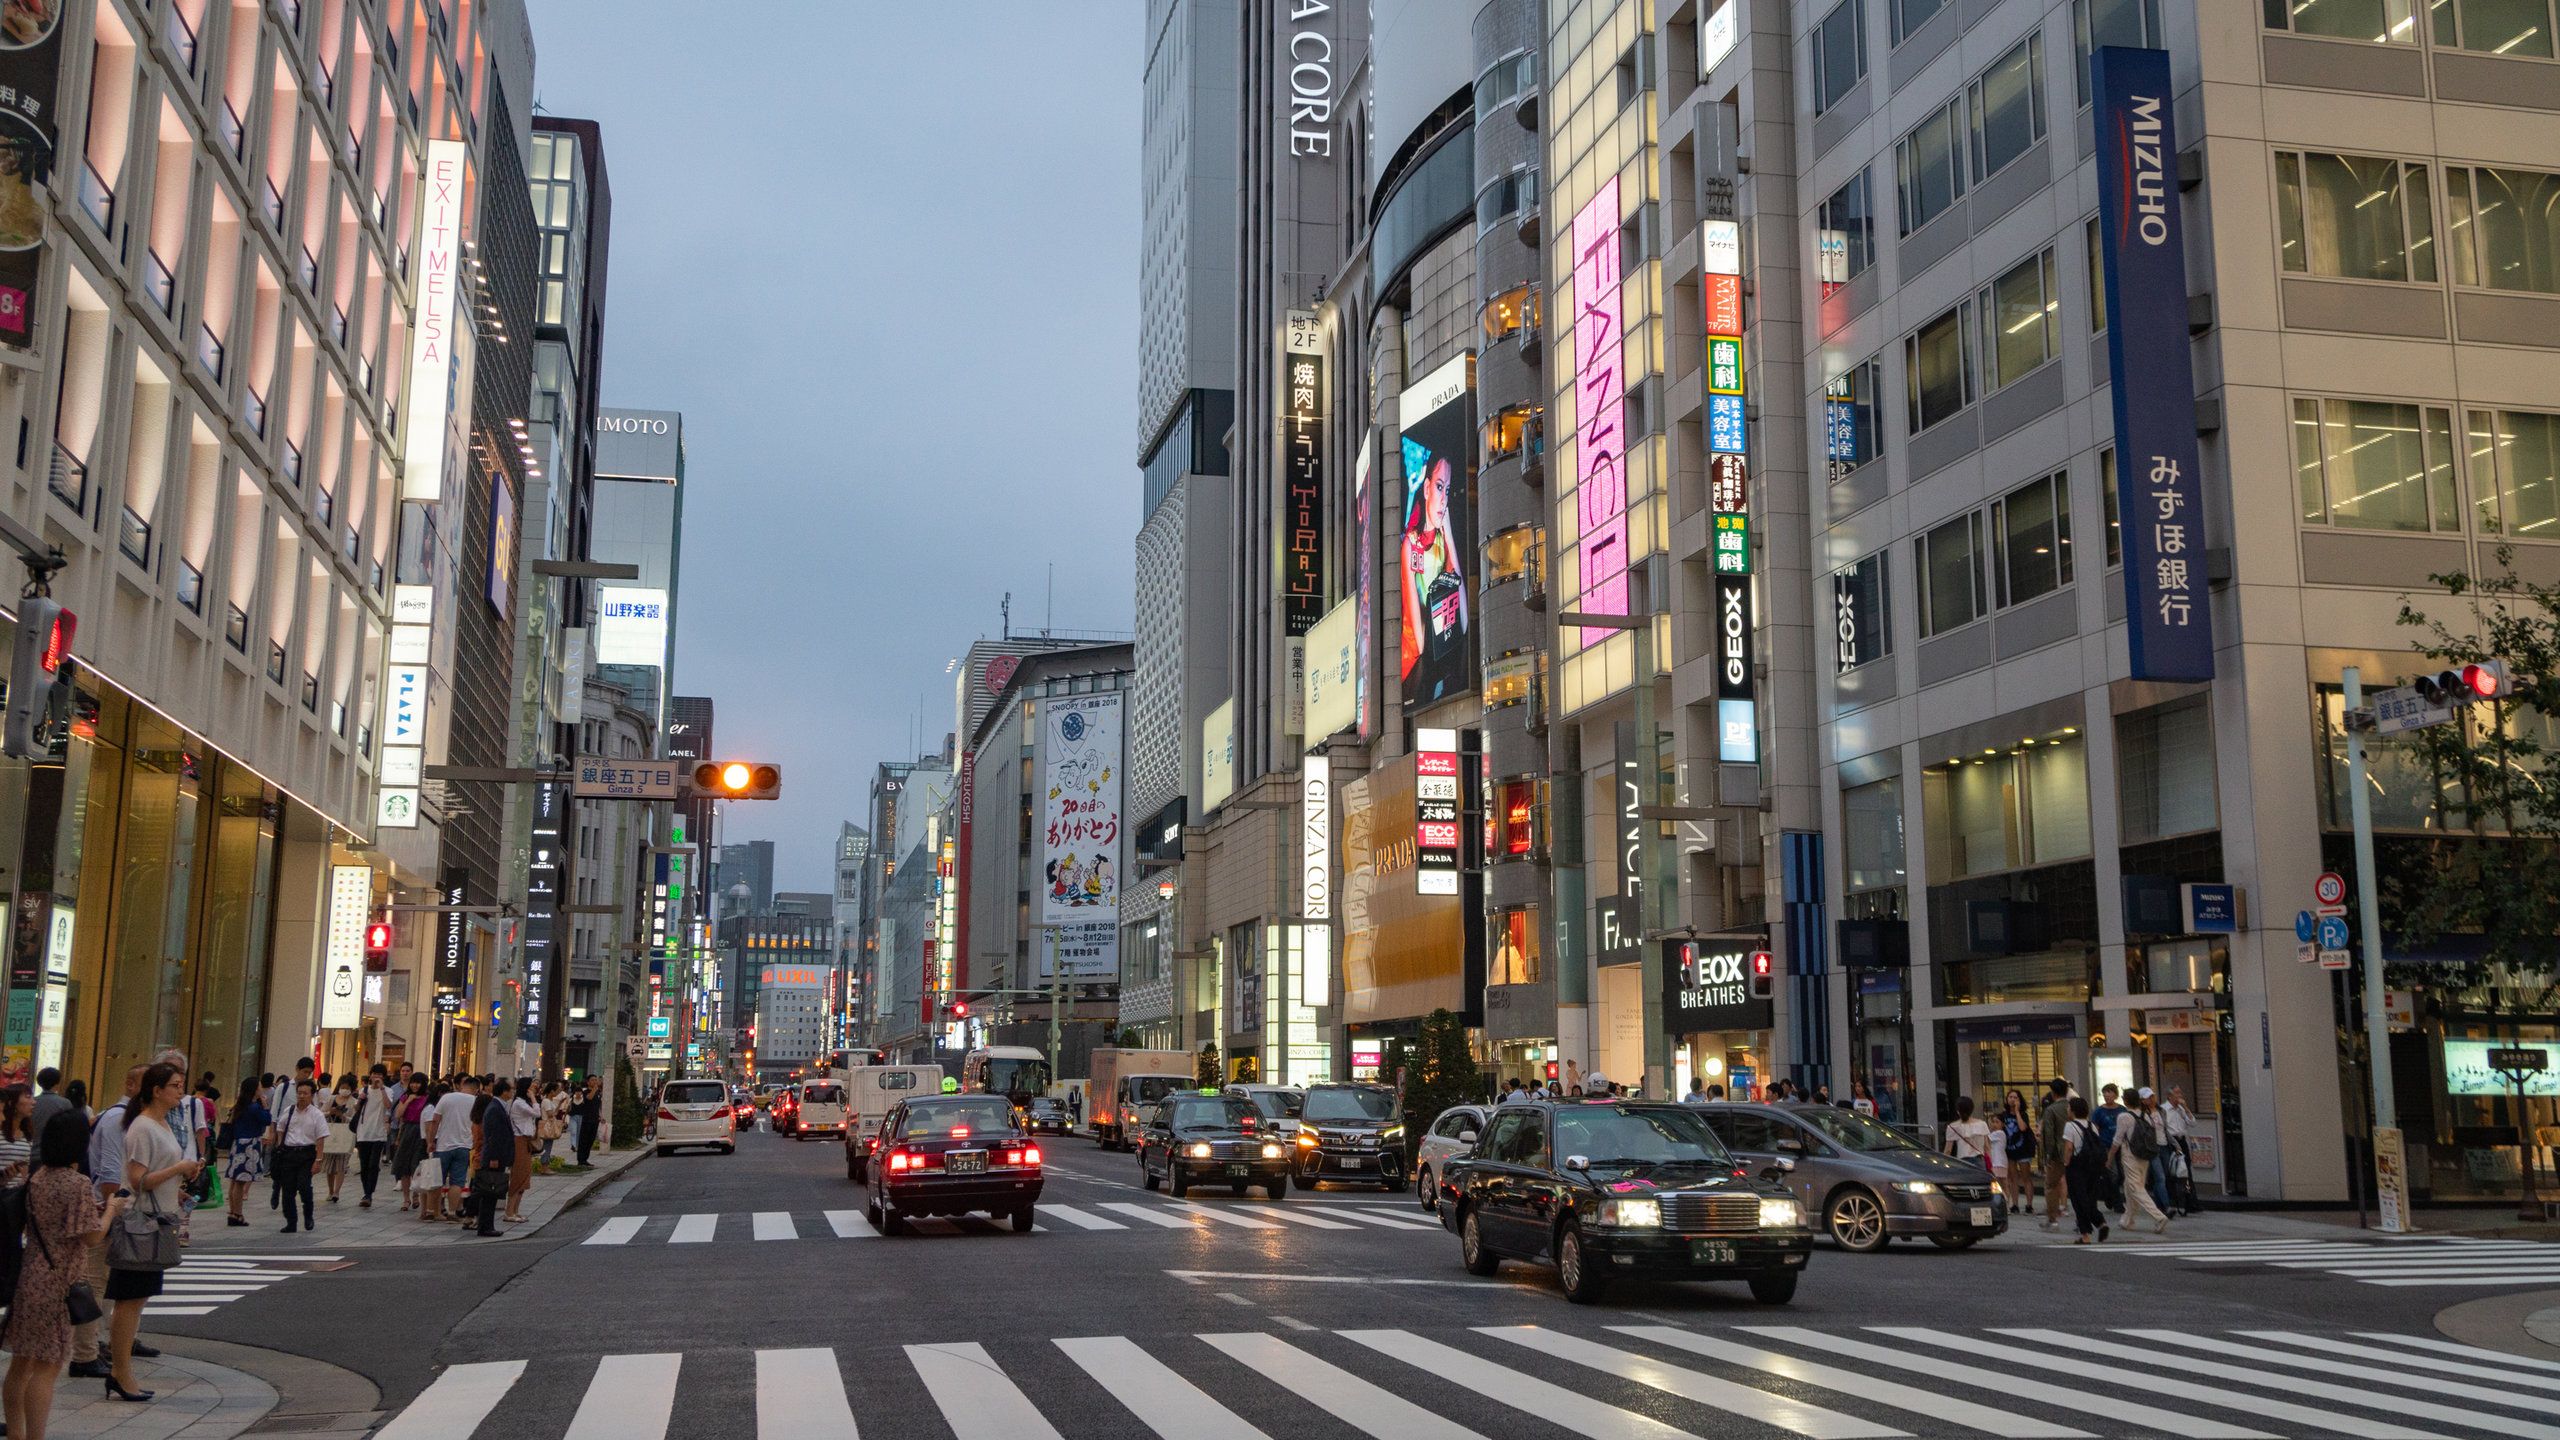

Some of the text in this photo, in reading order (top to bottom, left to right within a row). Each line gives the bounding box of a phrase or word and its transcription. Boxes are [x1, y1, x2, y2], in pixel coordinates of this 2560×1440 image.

[1290, 32, 1331, 157] CORE
[2131, 95, 2167, 246] MIZUHO
[422, 160, 454, 364] EXITMELSA
[1709, 240, 1735, 249] マイナビ
[1291, 315, 1320, 331] 地下
[1713, 341, 1737, 390] 歯科
[1430, 384, 1460, 410] PRADA
[1584, 228, 1616, 598] FANCL
[1292, 362, 1319, 479] 焼肉トラジ
[1713, 398, 1731, 449] 美容室
[495, 514, 511, 582] GU
[1292, 484, 1318, 608] TORAJI
[1718, 532, 1744, 573] 歯科
[2149, 455, 2192, 627] みずほ銀行
[604, 602, 661, 619] 山野楽器
[1725, 587, 1744, 685] GEOX
[564, 639, 582, 713] TASAKI
[397, 673, 415, 737] PLAZA
[1102, 698, 1118, 707] 2018
[581, 767, 671, 785] 銀座五丁目
[582, 759, 610, 768] 中央区
[608, 784, 643, 794] Ginza 5
[962, 756, 974, 825] MITSUKOSHI
[1046, 811, 1118, 849] ありがとう
[1306, 779, 1327, 857] GINZA
[1425, 825, 1455, 838] ECC
[1374, 836, 1416, 877] PRADA
[1422, 854, 1453, 863] PRADA
[2322, 881, 2339, 896] 30
[446, 887, 463, 968] WAHINGTON
[1084, 923, 1098, 932] 銀座
[1098, 923, 1115, 931] 2018
[777, 970, 817, 985] LIXIL
[1680, 952, 1744, 985] EOX
[527, 960, 543, 1025] 銀座大黒屋
[1680, 985, 1745, 1009] BREATHES
[9, 1017, 32, 1032] B1F
[957, 1160, 982, 1171] 54-72
